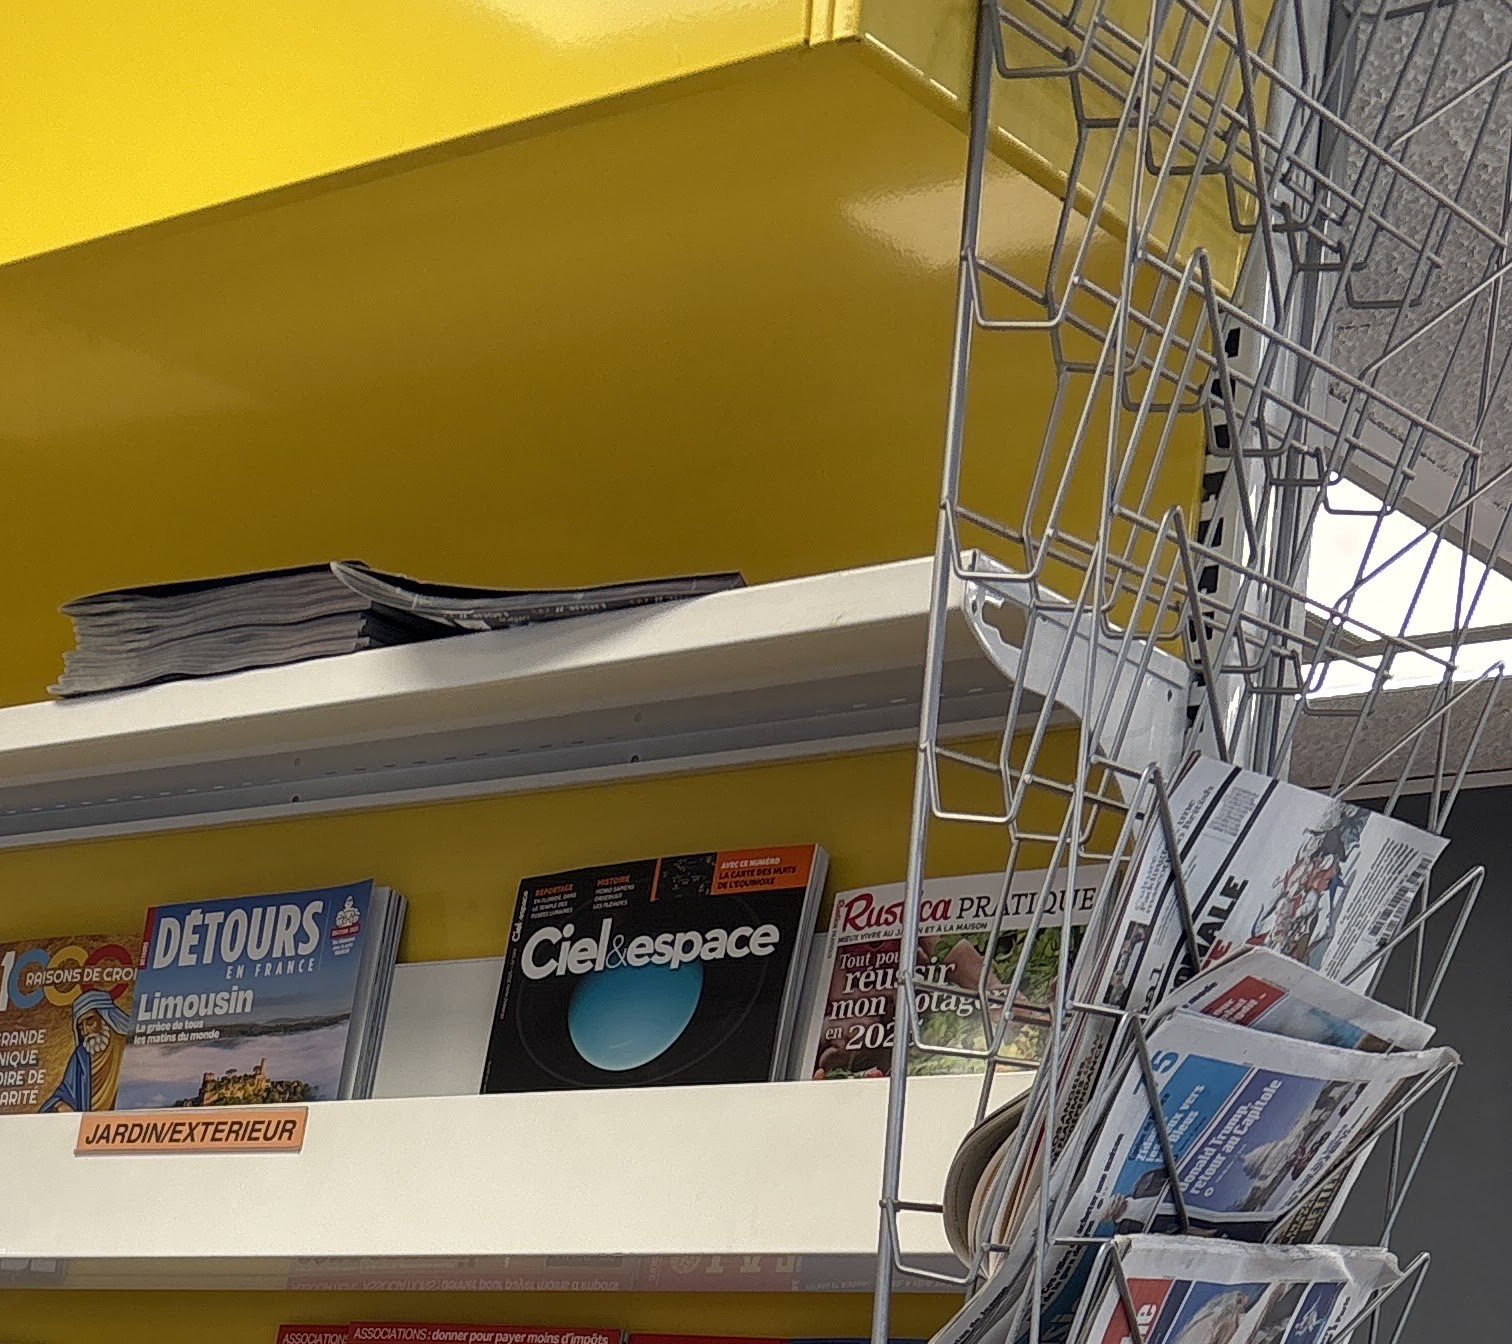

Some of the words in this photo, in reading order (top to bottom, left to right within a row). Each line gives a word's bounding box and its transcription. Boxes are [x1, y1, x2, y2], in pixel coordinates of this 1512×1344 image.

[956, 886, 1099, 921] PRATIQUE
[152, 900, 324, 971] DÉTOURS
[520, 918, 781, 982] Ciel&espace
[224, 964, 246, 980] EN
[254, 958, 316, 979] FRANCE
[136, 984, 254, 1022] Limousin
[28, 1069, 47, 1085] DE
[1237, 1078, 1283, 1136] Capitole
[85, 1119, 298, 1146] JARDIN/EXTERIEUR
[1189, 1151, 1227, 1195] retour
[432, 1329, 468, 1341] donner
[469, 1332, 493, 1344] pour
[527, 1333, 559, 1344] moins
